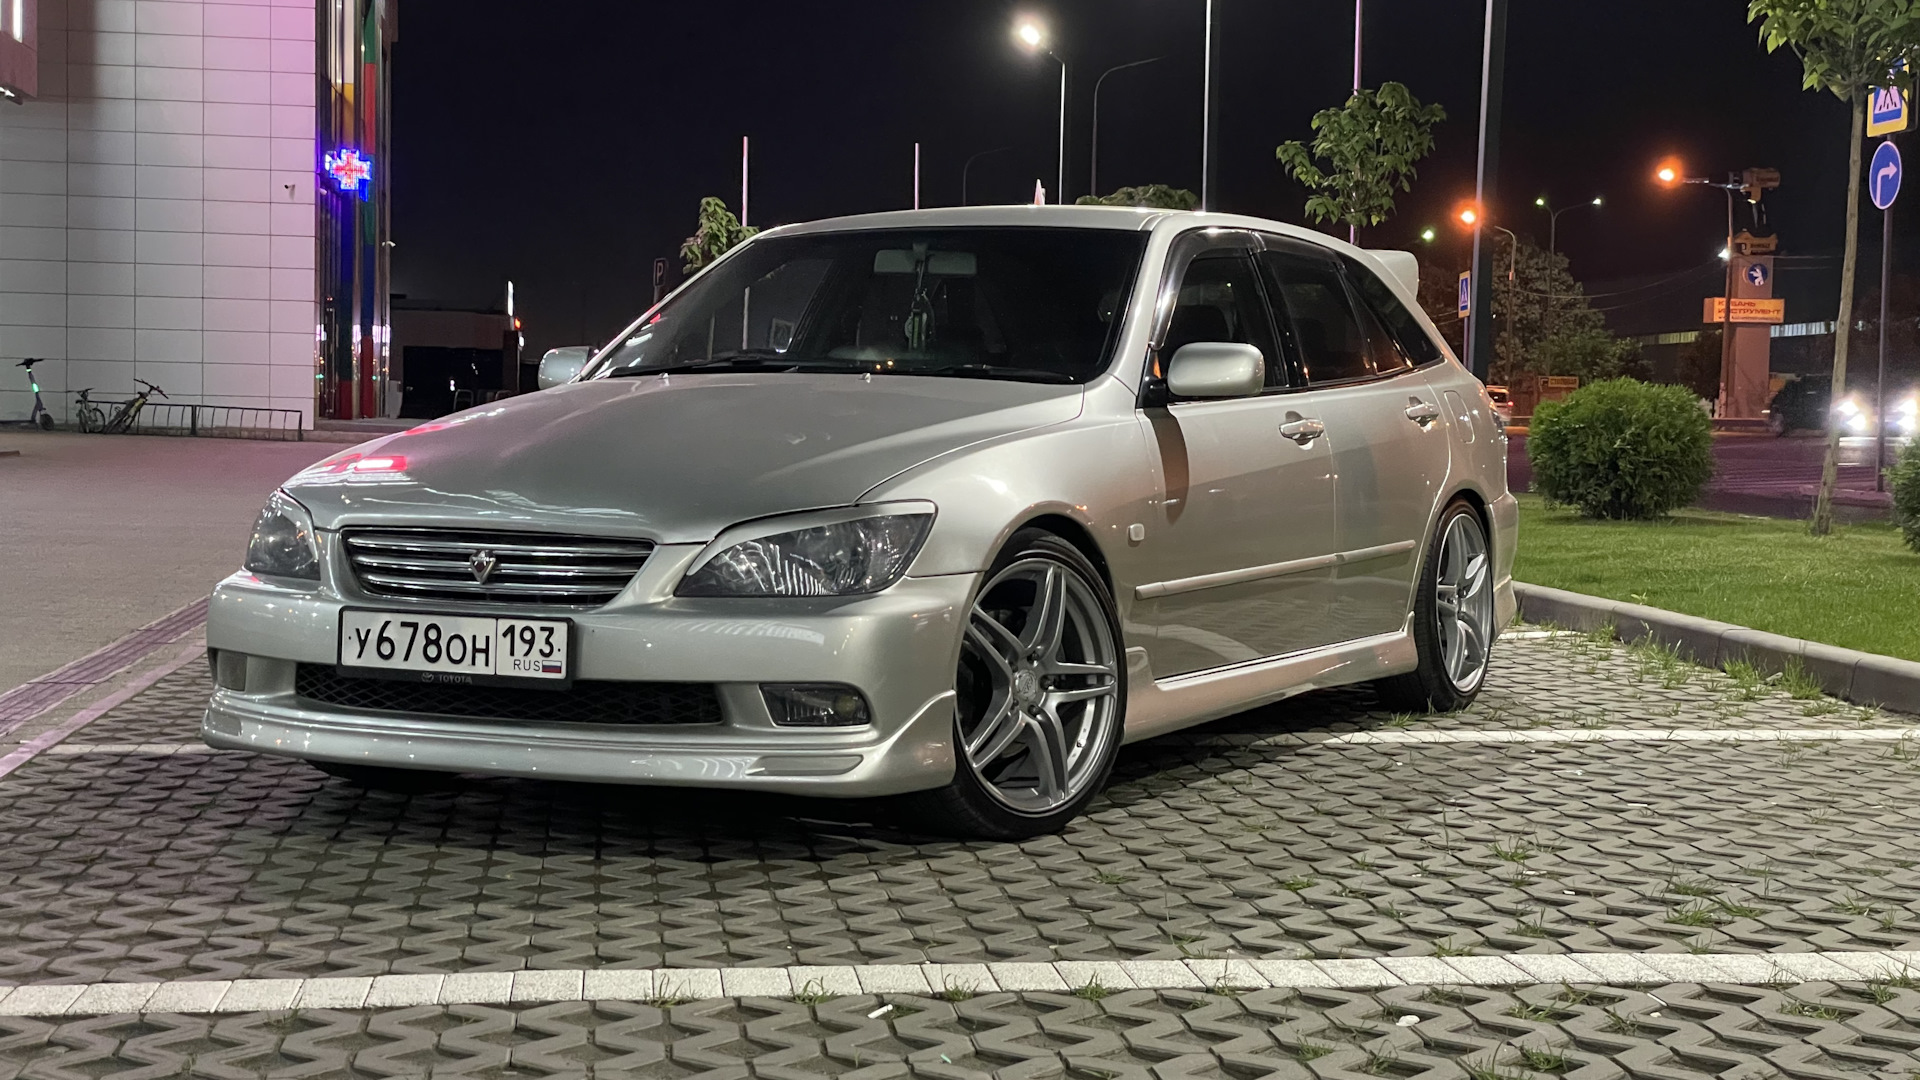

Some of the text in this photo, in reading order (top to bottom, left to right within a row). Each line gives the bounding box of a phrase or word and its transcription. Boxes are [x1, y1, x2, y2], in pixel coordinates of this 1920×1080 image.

[502, 624, 555, 658] 193
[513, 659, 541, 672] RUS
[439, 674, 473, 685] TOYOTA
